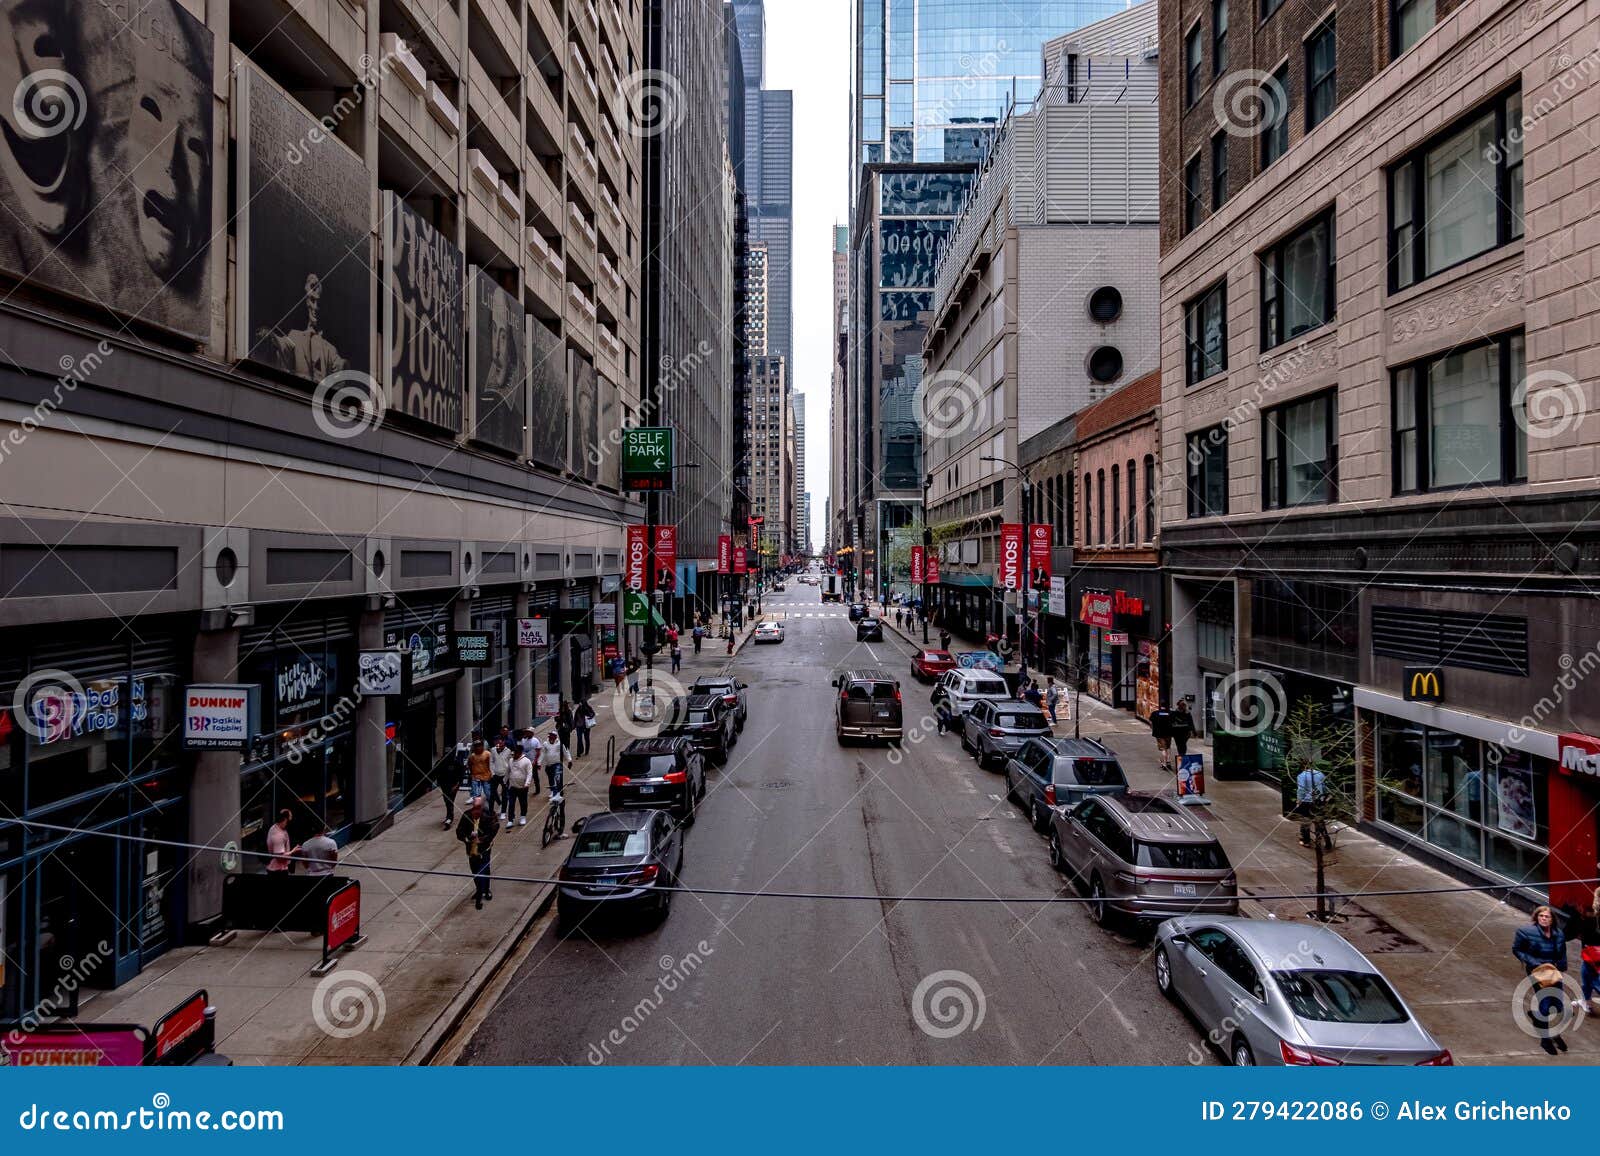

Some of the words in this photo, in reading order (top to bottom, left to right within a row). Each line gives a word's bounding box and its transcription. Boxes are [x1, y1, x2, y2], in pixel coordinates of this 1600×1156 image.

[629, 432, 664, 444] SELF
[629, 445, 665, 456] PARK
[631, 542, 643, 589] SOUND
[1005, 541, 1017, 589] SOUND
[190, 697, 245, 708] DUNKIN'
